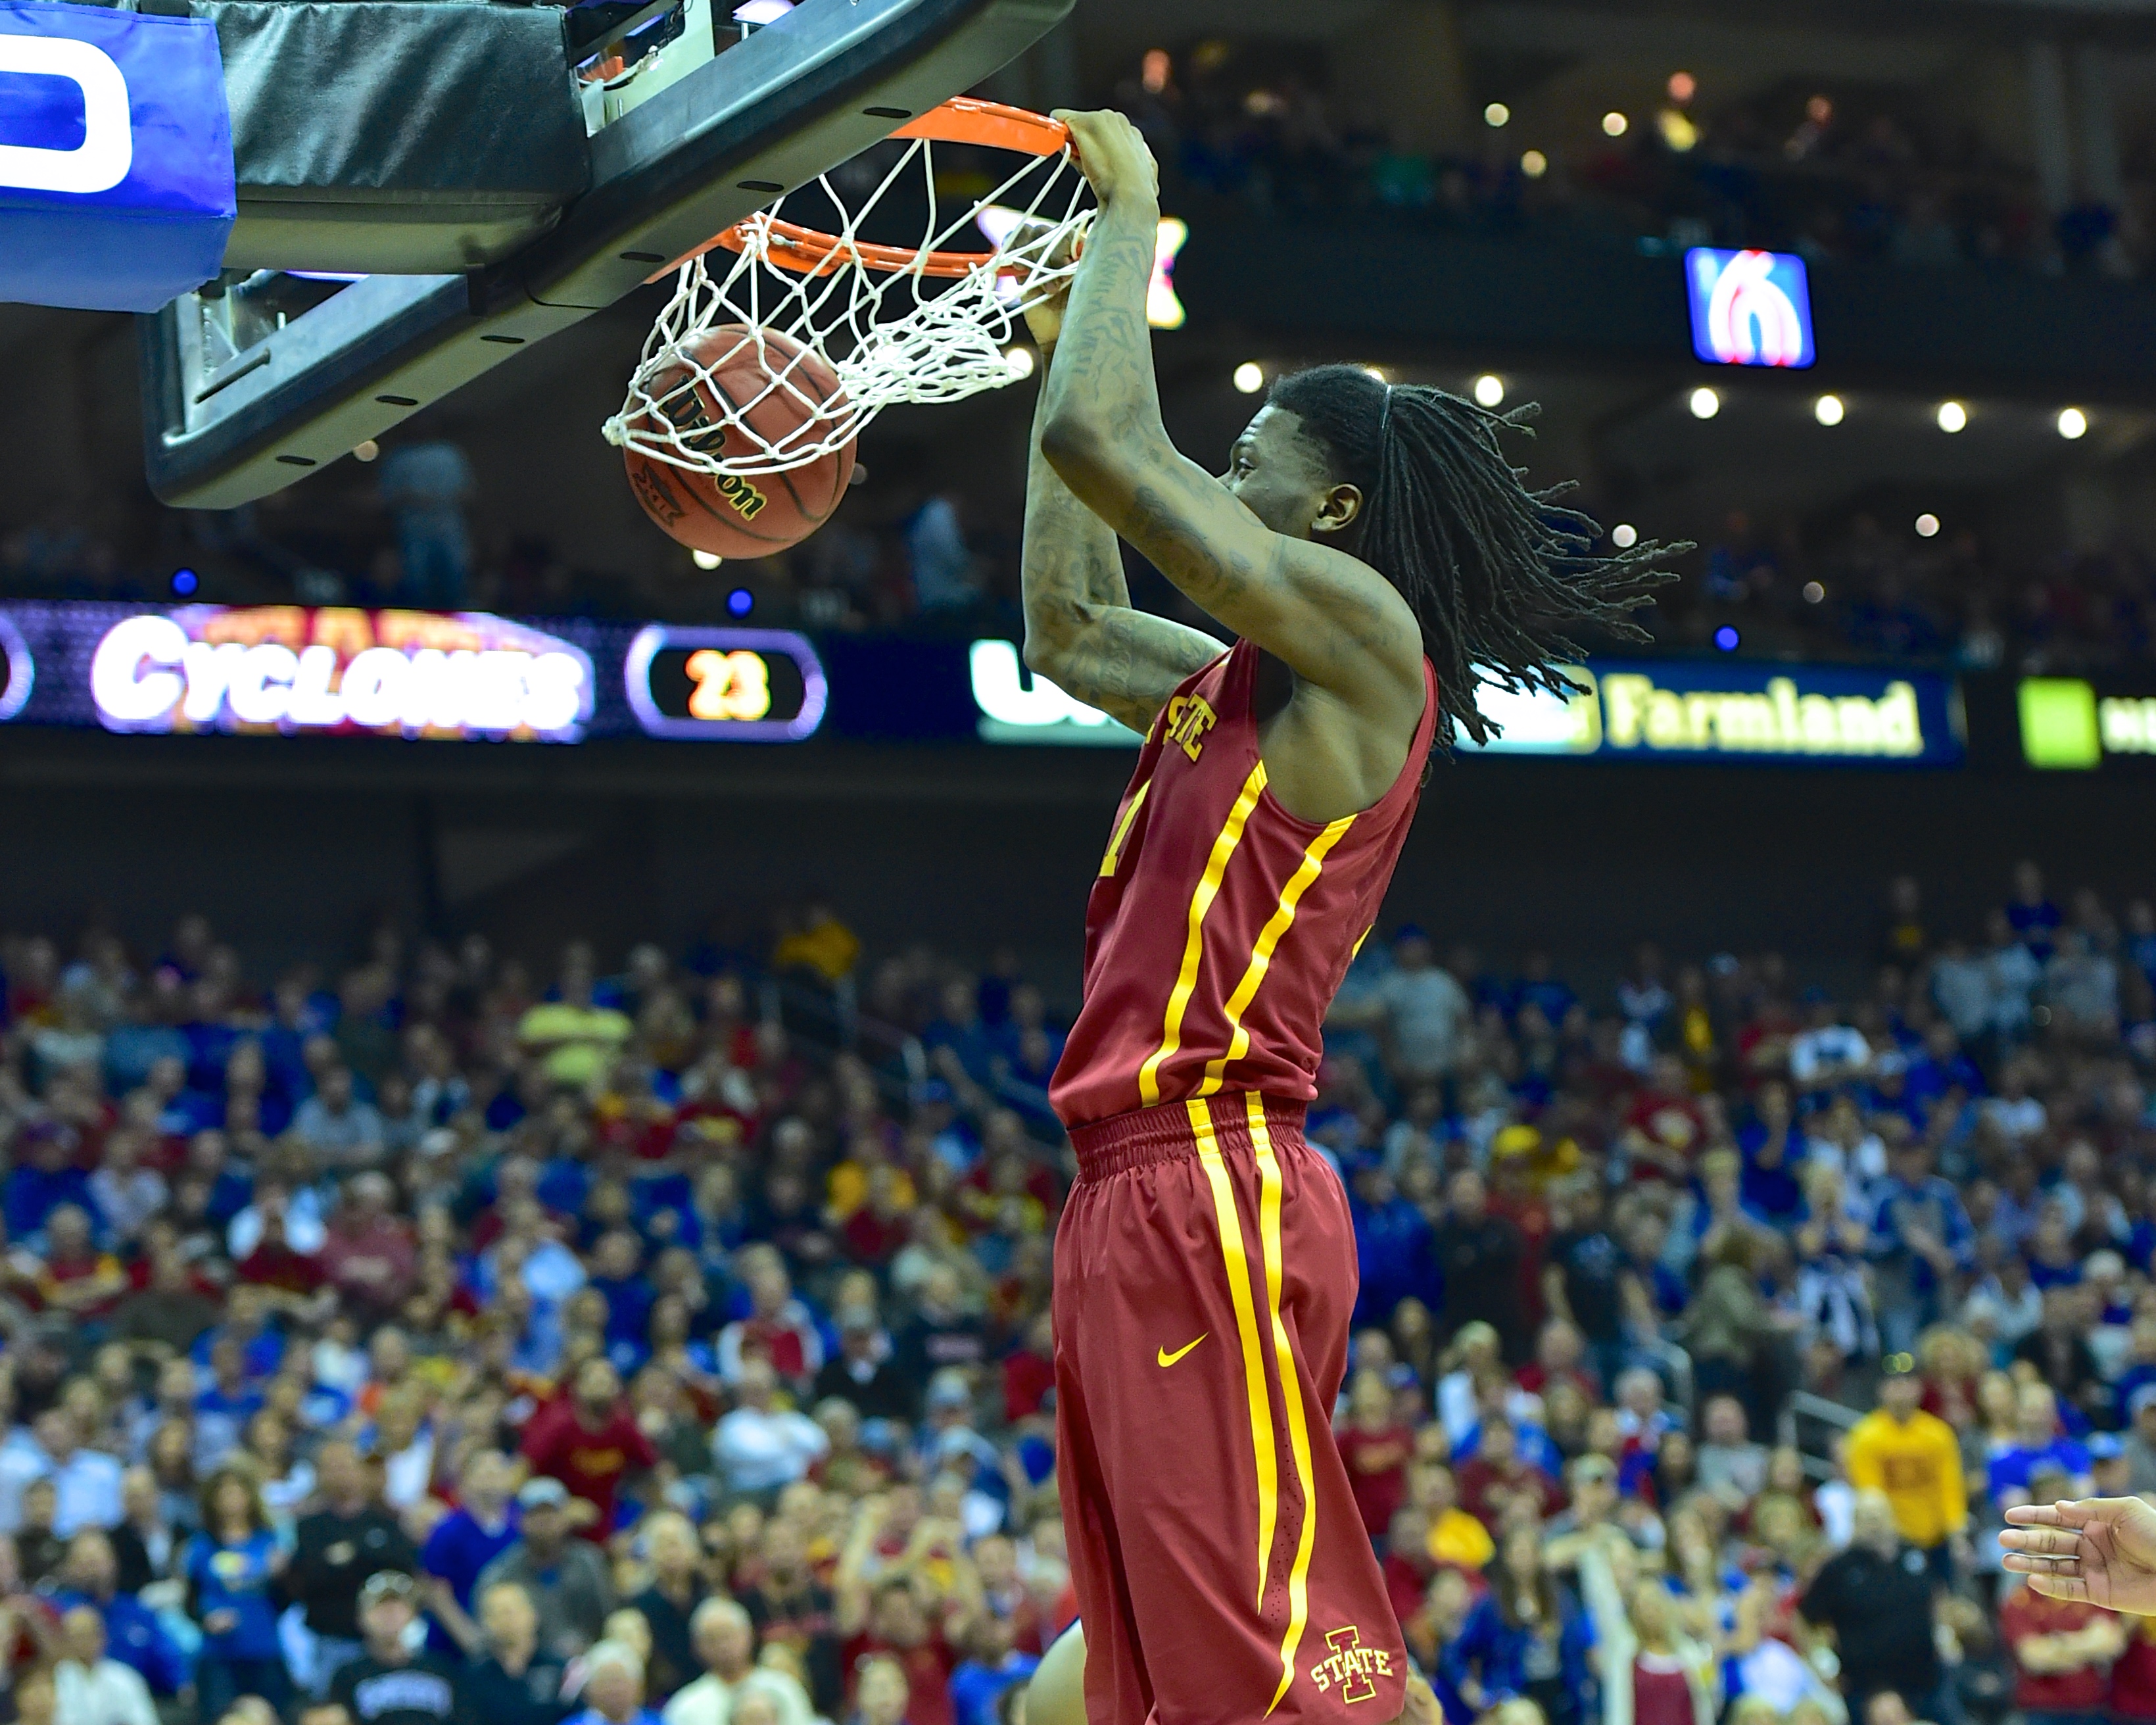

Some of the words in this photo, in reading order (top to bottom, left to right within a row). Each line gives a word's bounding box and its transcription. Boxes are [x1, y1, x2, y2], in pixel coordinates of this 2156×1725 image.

[659, 374, 767, 522] Wilon
[1602, 673, 1924, 756] Farmland
[1310, 1649, 1393, 1693] STATE
